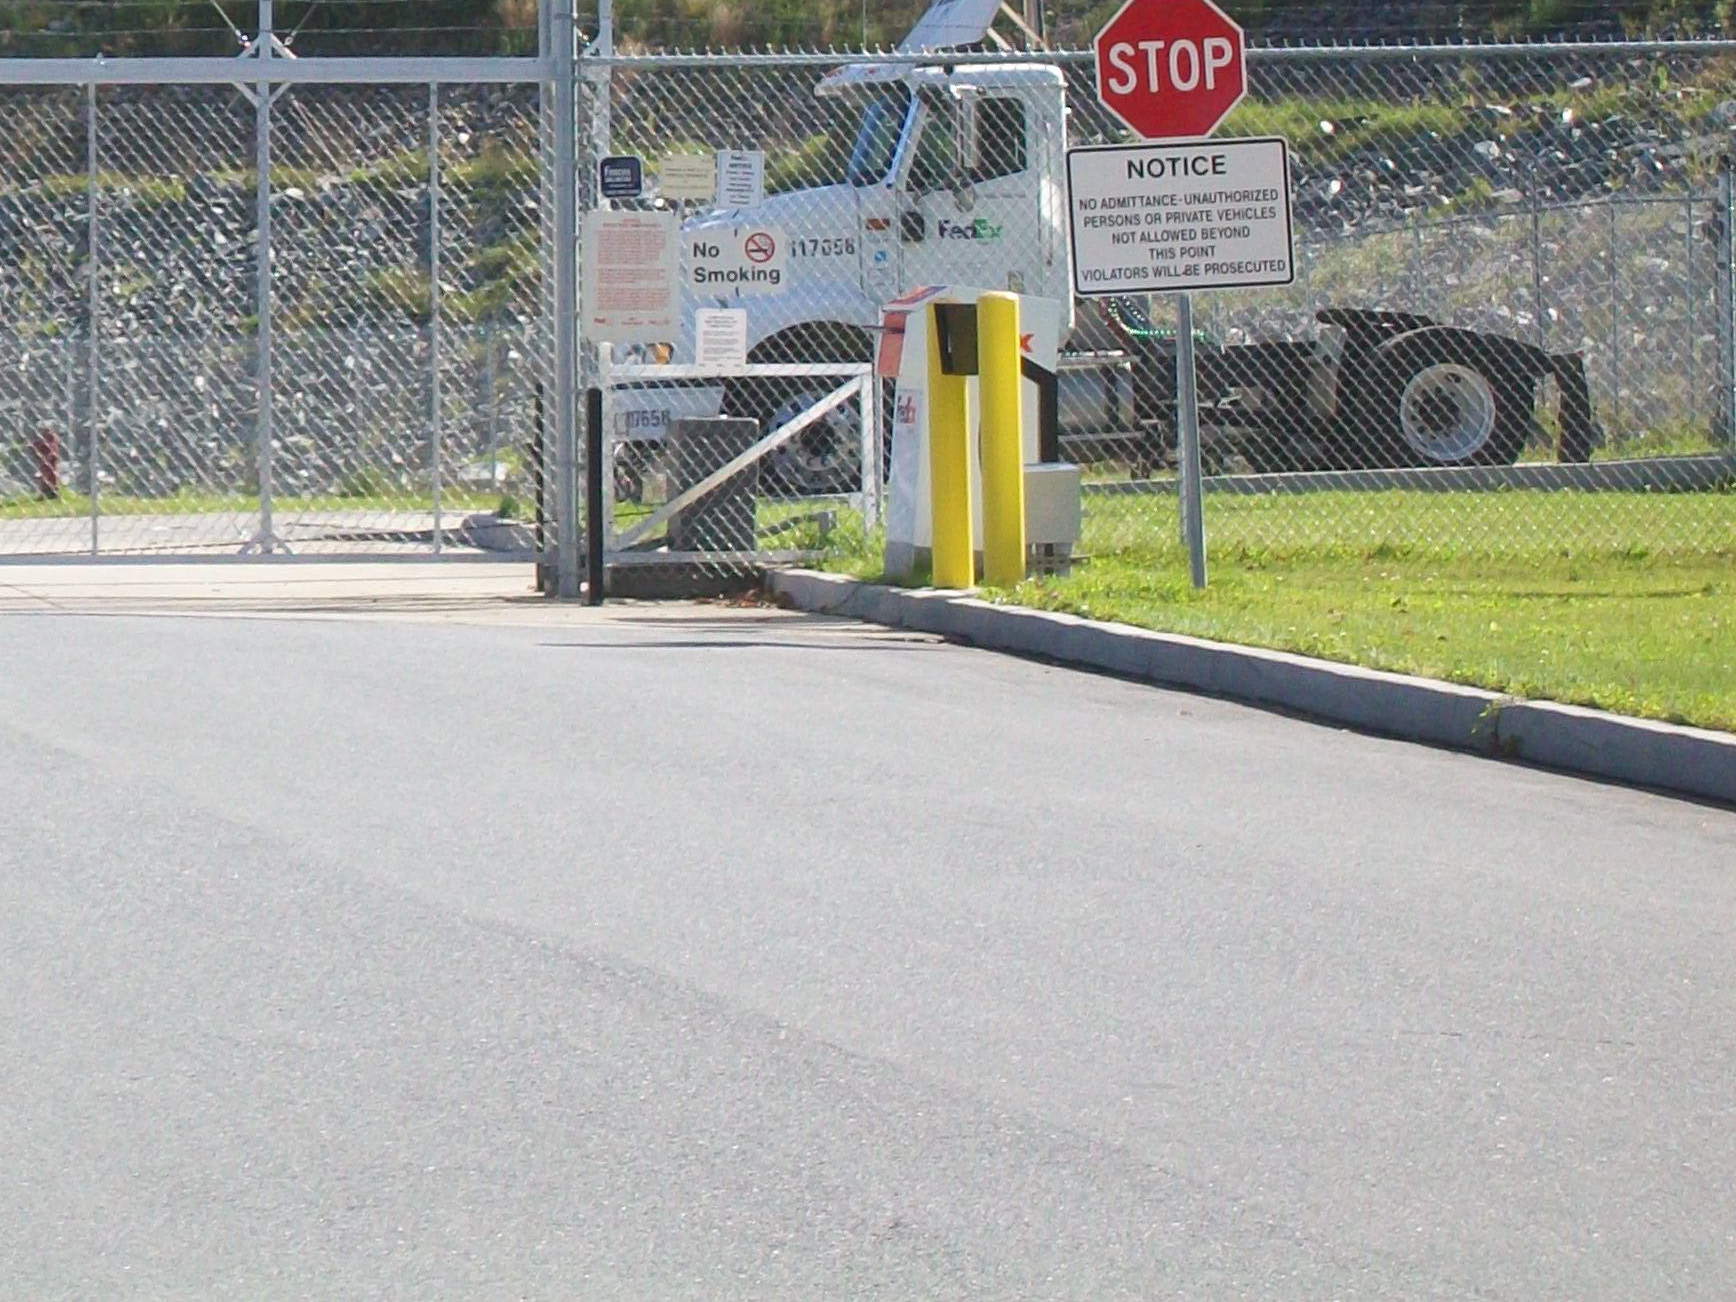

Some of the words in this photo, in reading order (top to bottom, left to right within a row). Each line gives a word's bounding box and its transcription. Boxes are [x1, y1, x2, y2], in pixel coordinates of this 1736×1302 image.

[1108, 37, 1234, 95] STOP
[1127, 155, 1227, 179] NOTICE
[1079, 198, 1097, 210] NO
[1083, 213, 1141, 228] PERSONS
[1145, 212, 1162, 225] OR
[1166, 209, 1213, 224] PRIVATE
[1217, 206, 1276, 222] VEHICLES
[938, 218, 1002, 239] FedEx
[1112, 231, 1135, 245] NOT
[1139, 228, 1197, 244] ALLOWED
[1201, 225, 1250, 240] BEYOND
[693, 242, 720, 258] No
[1149, 247, 1176, 260] THIS
[1180, 245, 1216, 259] POINT
[694, 266, 781, 285] Smoking
[1081, 266, 1149, 282] VIOLATORS
[1153, 264, 1182, 278] WILL
[1185, 263, 1200, 276] BE
[1204, 259, 1286, 275] PROSECUTED
